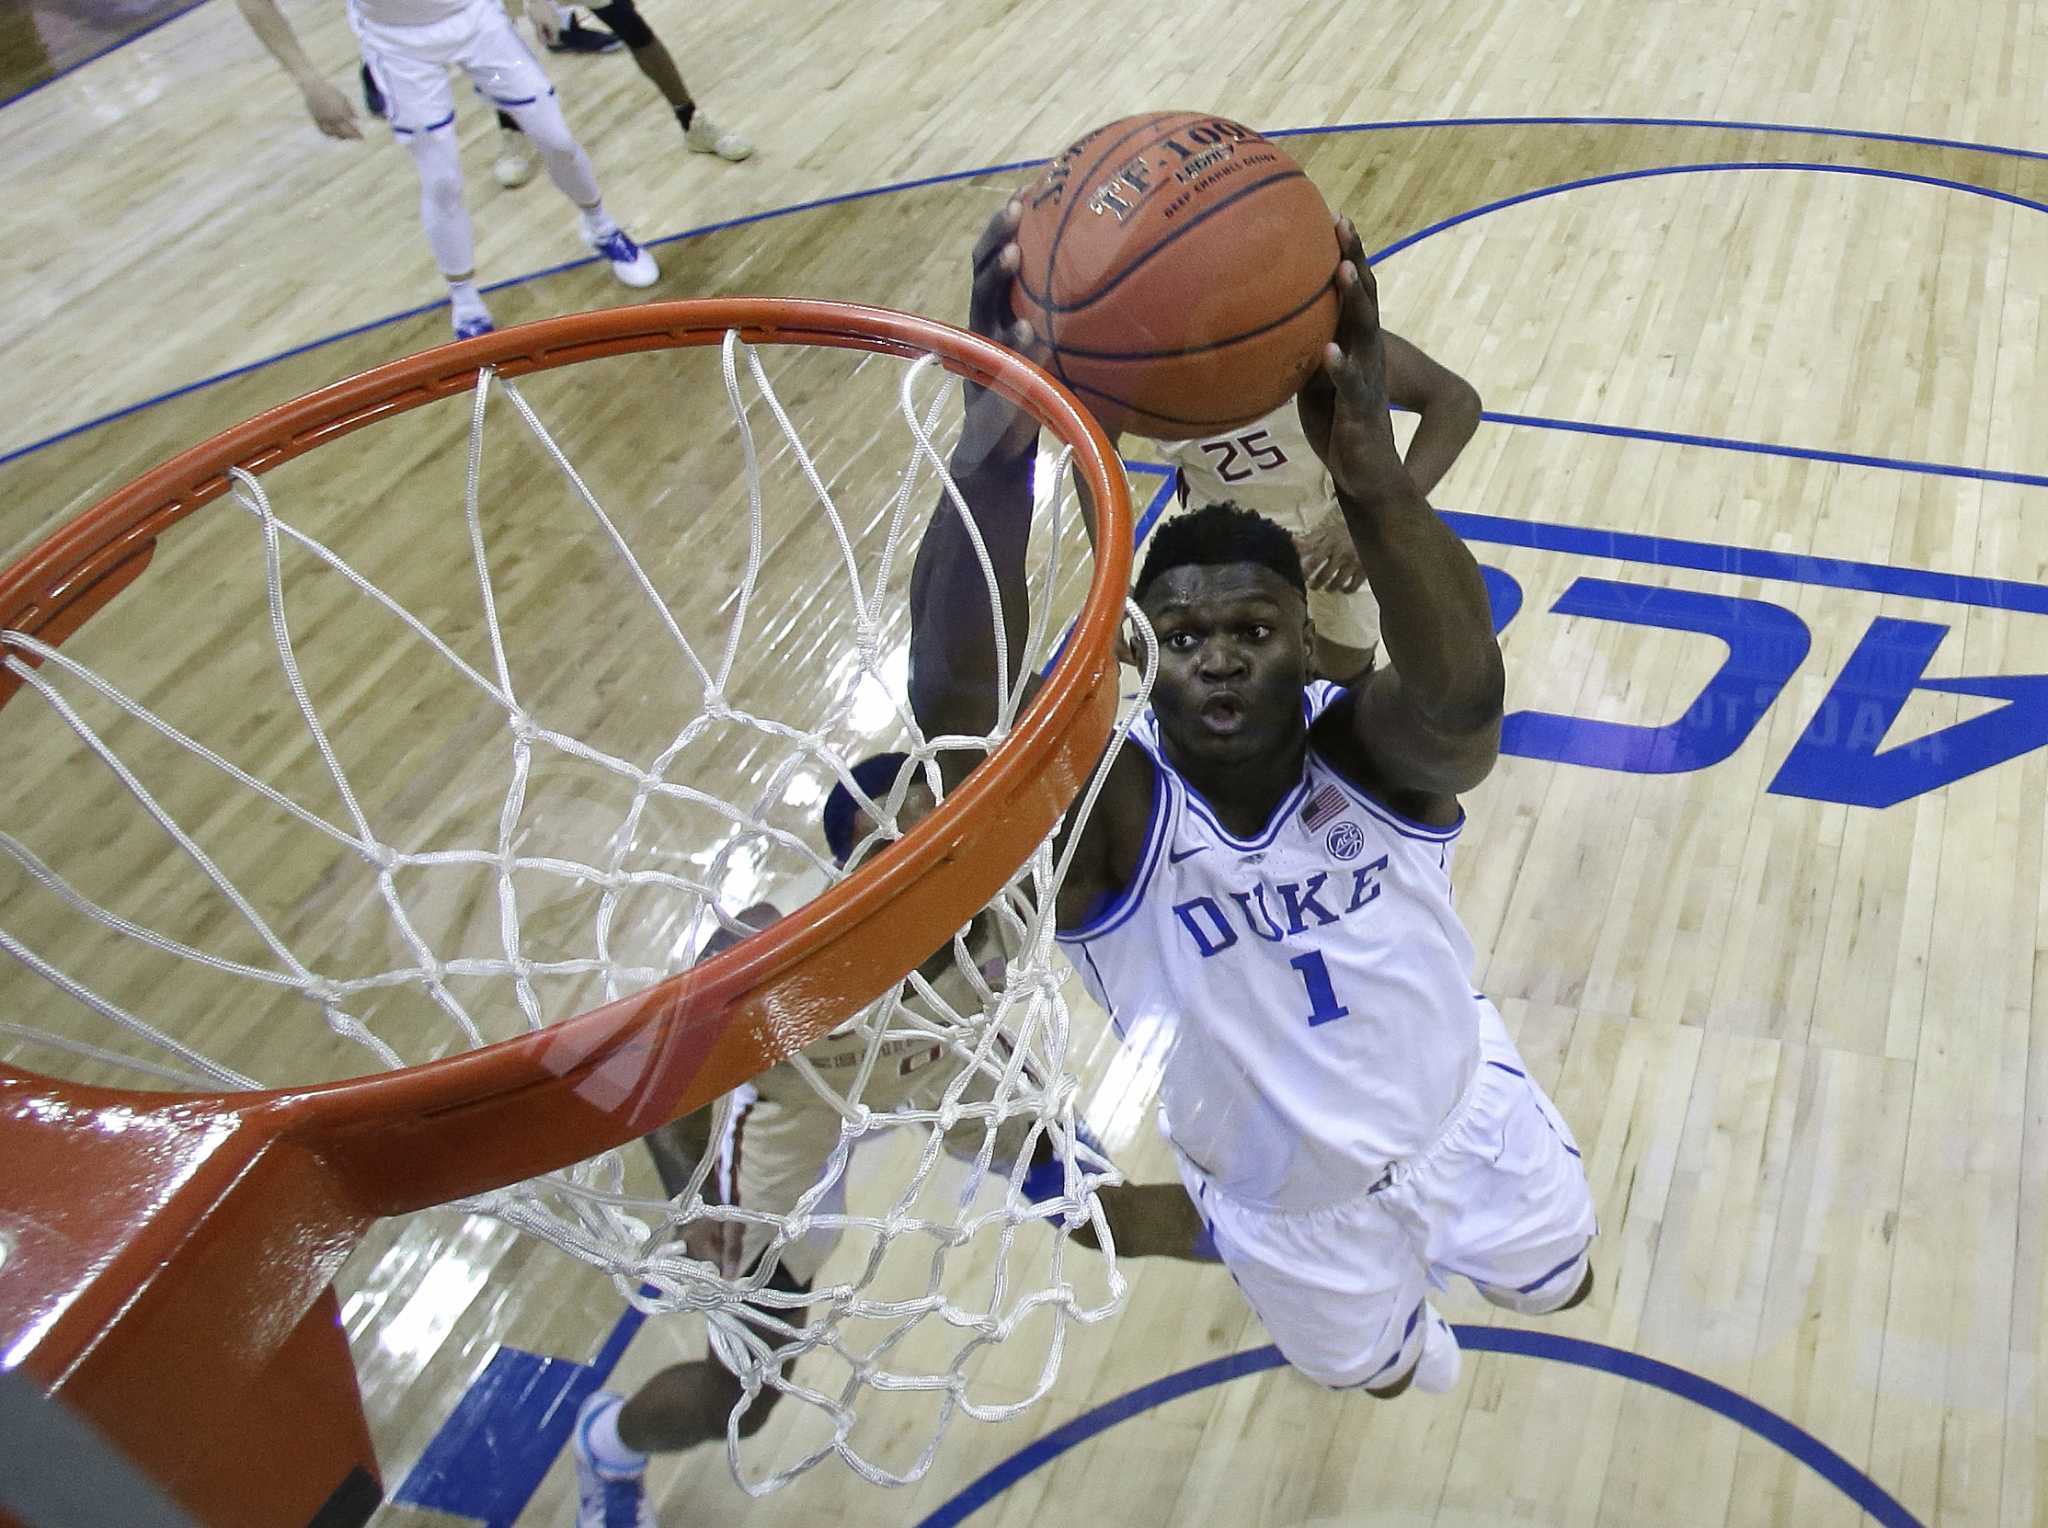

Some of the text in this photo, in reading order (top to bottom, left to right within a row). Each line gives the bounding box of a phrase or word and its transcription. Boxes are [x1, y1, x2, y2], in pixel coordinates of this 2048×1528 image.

[1200, 429, 1288, 482] 25
[1172, 854, 1388, 958] DUKE
[1289, 949, 1349, 1027] 1
